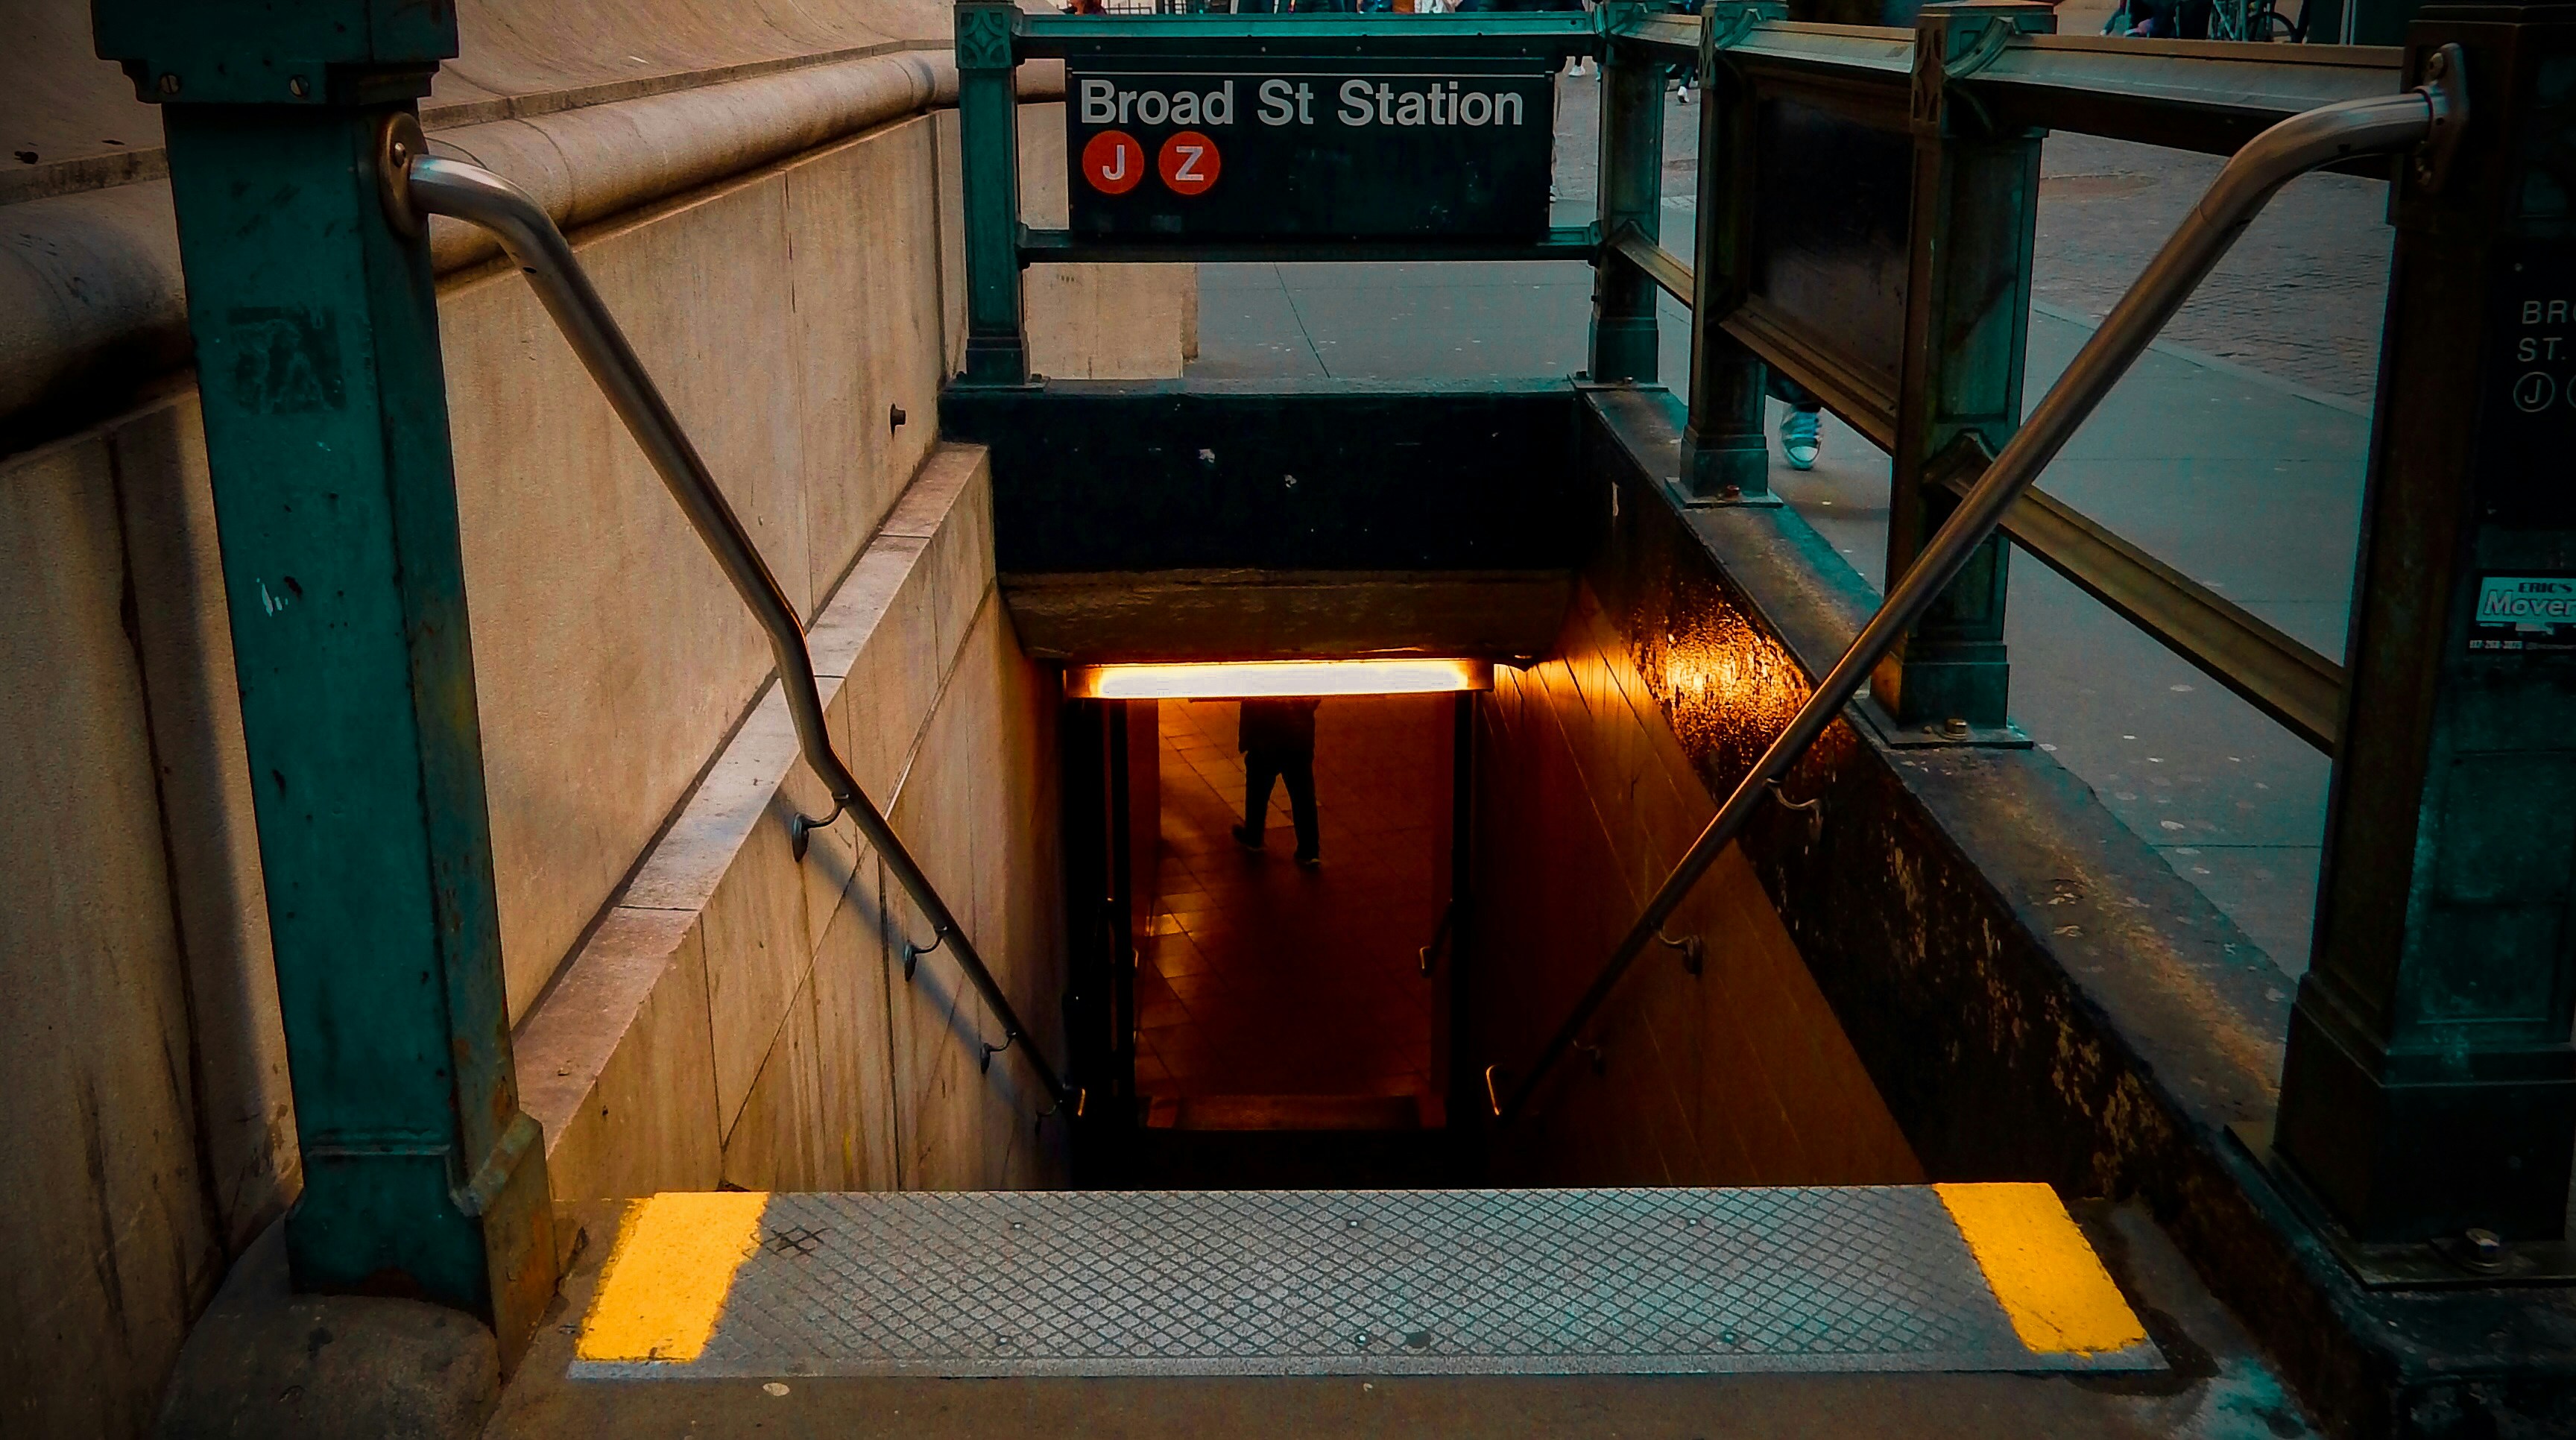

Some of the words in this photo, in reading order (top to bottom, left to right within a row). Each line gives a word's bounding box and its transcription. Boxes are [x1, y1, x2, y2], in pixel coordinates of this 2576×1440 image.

[1080, 79, 1234, 125] Broad
[1257, 79, 1314, 126] St
[1337, 80, 1523, 126] Station
[1101, 144, 1126, 181] J
[1175, 145, 1205, 182] Z
[2516, 337, 2567, 362] ST.
[2524, 379, 2542, 404] J
